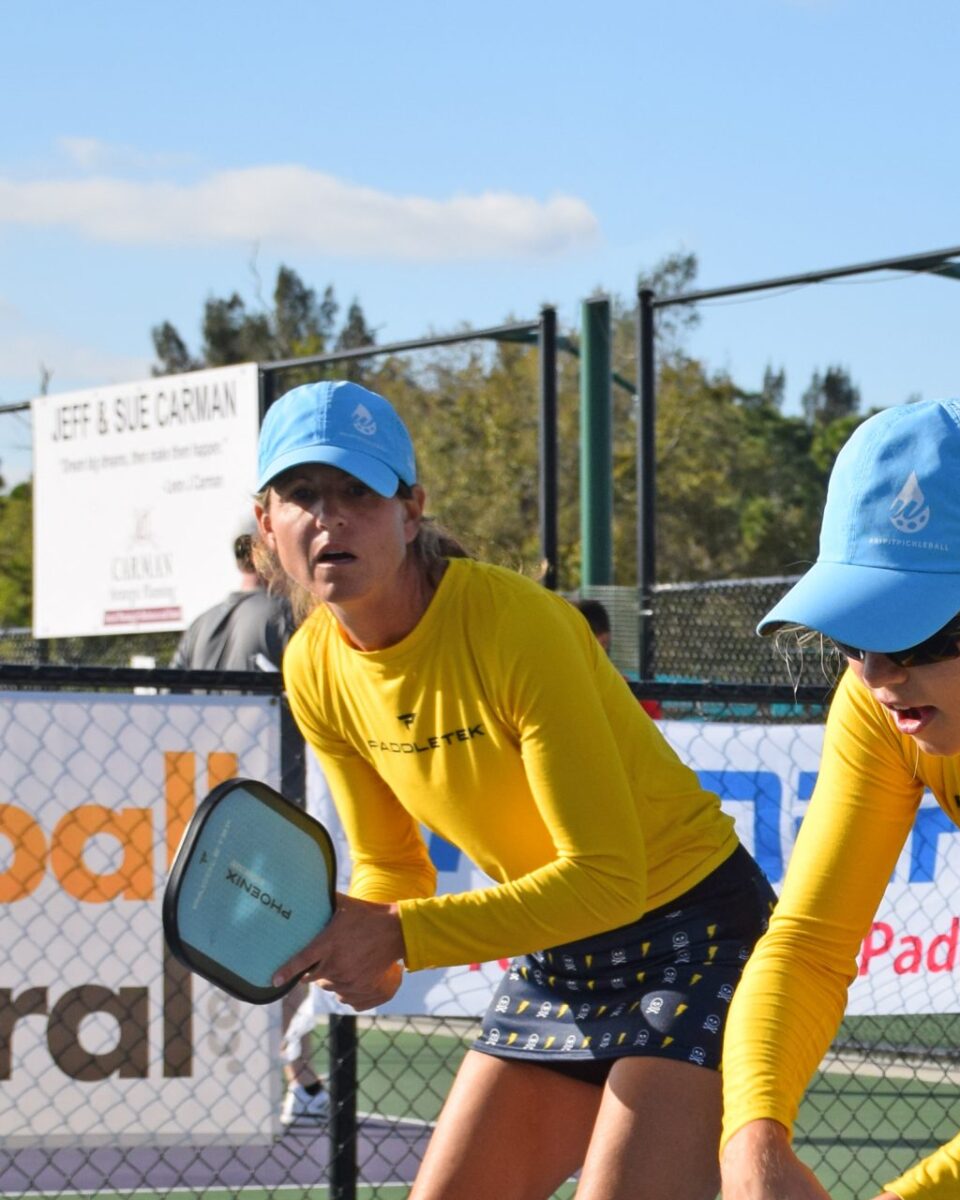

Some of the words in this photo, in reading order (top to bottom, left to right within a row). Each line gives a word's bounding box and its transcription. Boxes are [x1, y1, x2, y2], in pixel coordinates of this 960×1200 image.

[52, 402, 91, 442] JEFF
[97, 401, 109, 436] &
[115, 394, 150, 434] SUE
[156, 380, 237, 427] CARMAN
[367, 723, 486, 754] PADDLETEK
[225, 867, 293, 921] PHOENIX
